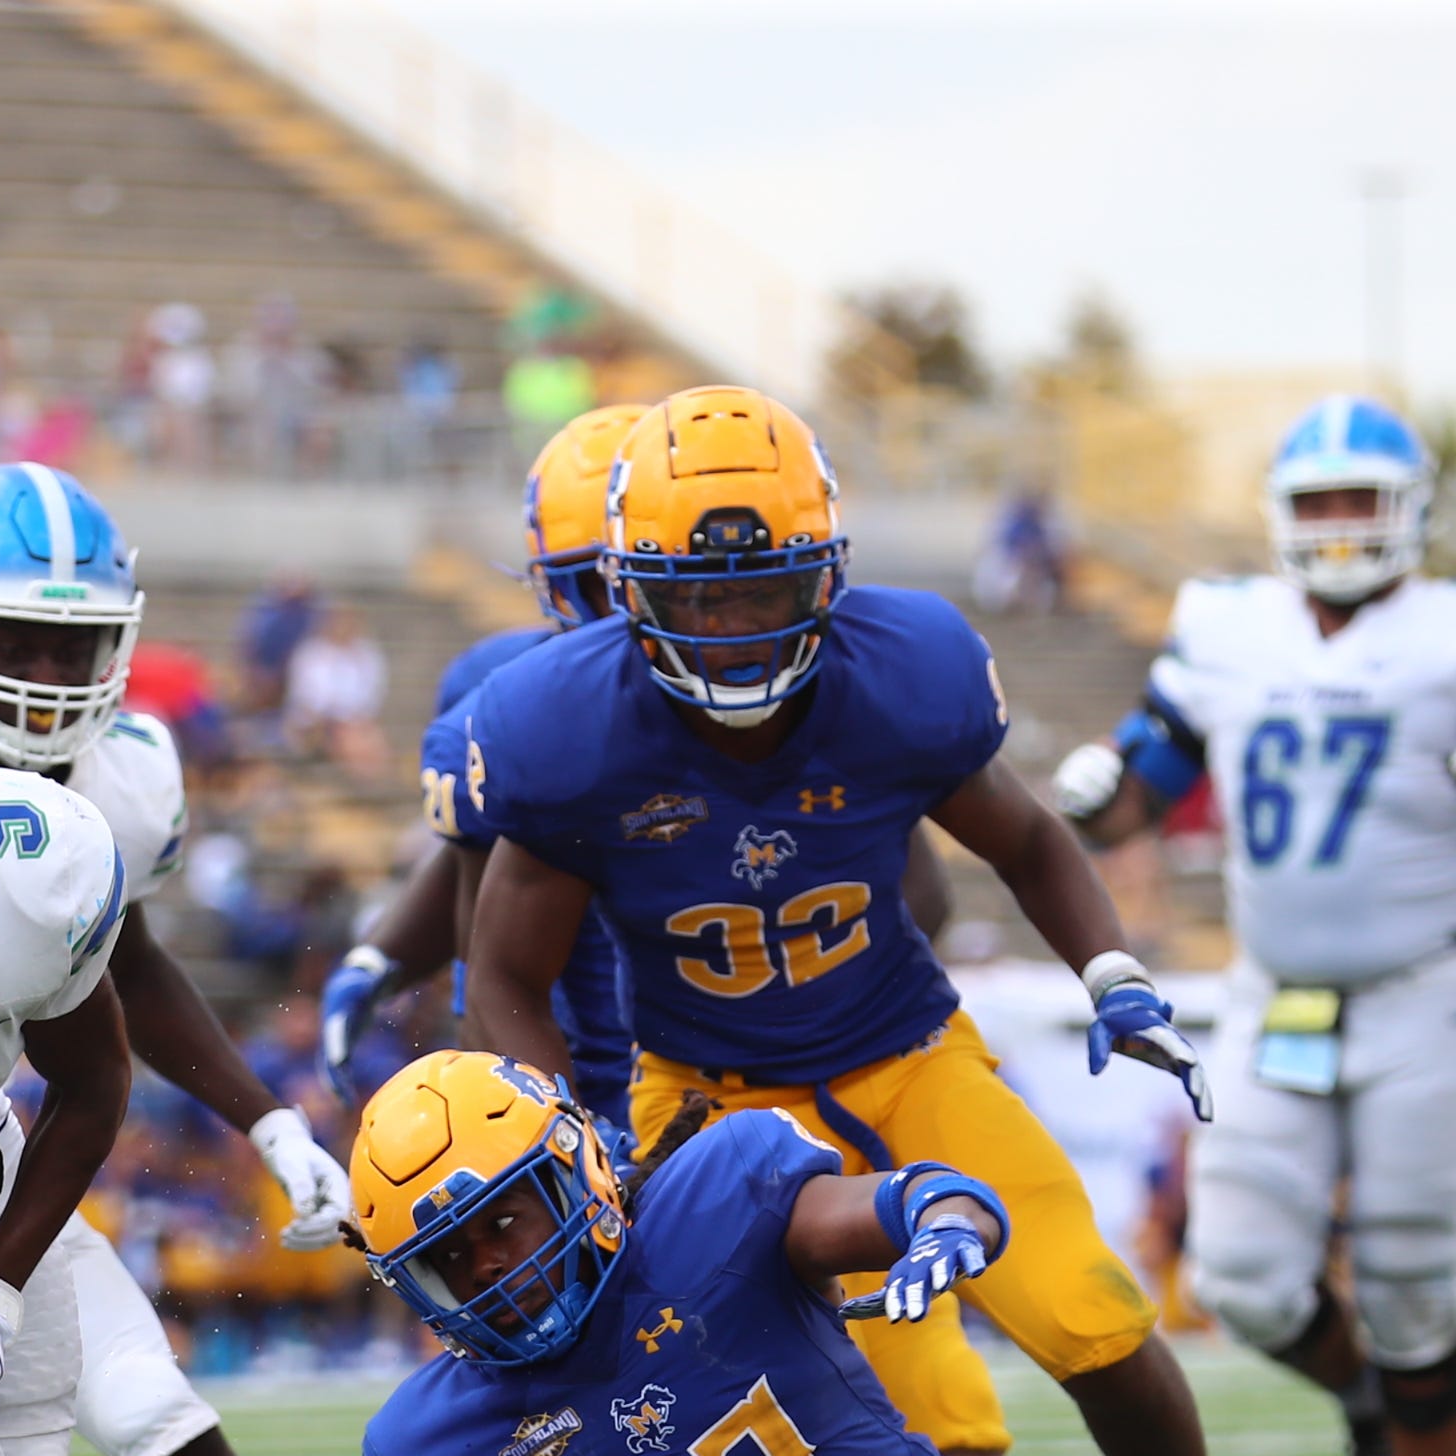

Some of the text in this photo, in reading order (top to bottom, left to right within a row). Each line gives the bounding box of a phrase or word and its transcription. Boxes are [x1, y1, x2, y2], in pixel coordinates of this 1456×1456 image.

[1240, 710, 1398, 872] 67
[665, 880, 872, 998] 32
[429, 1185, 454, 1210] M
[627, 1402, 662, 1436] M
